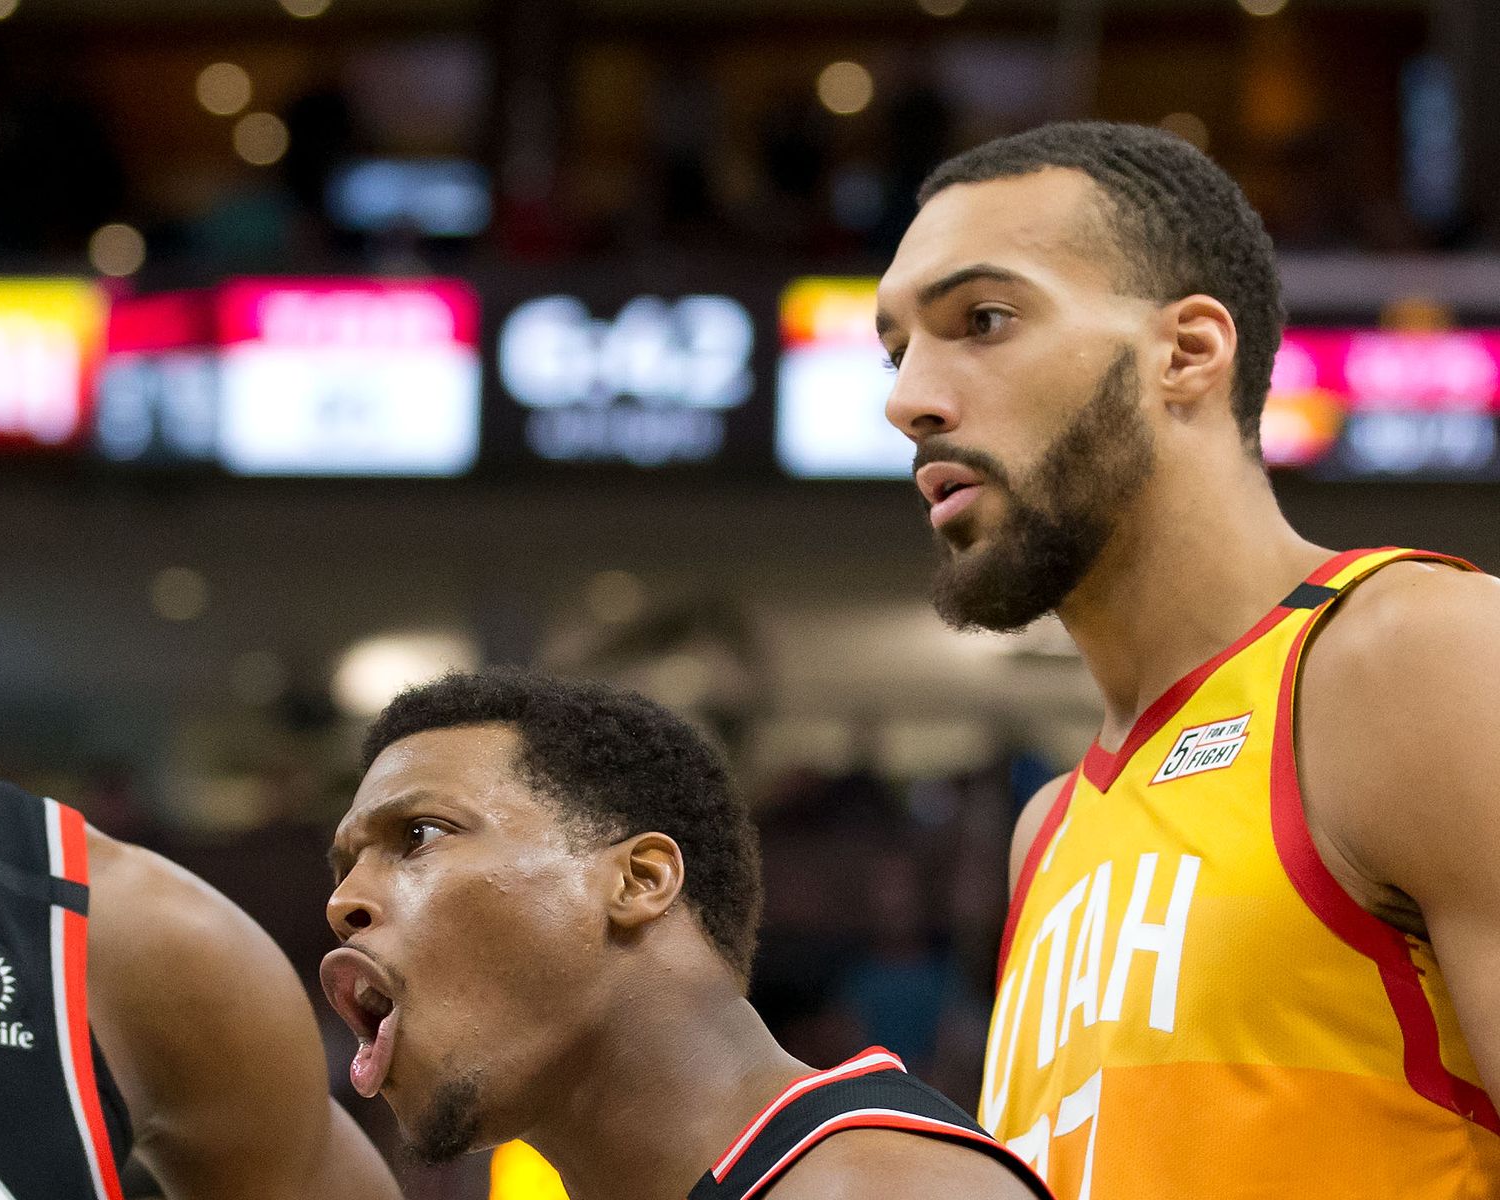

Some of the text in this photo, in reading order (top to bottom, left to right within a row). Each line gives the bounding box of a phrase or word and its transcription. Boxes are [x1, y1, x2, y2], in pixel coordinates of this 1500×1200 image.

[1206, 727, 1226, 739] FOR
[1163, 733, 1199, 776] 5
[1186, 744, 1238, 770] FIGHT
[983, 853, 1201, 1139] UTAH
